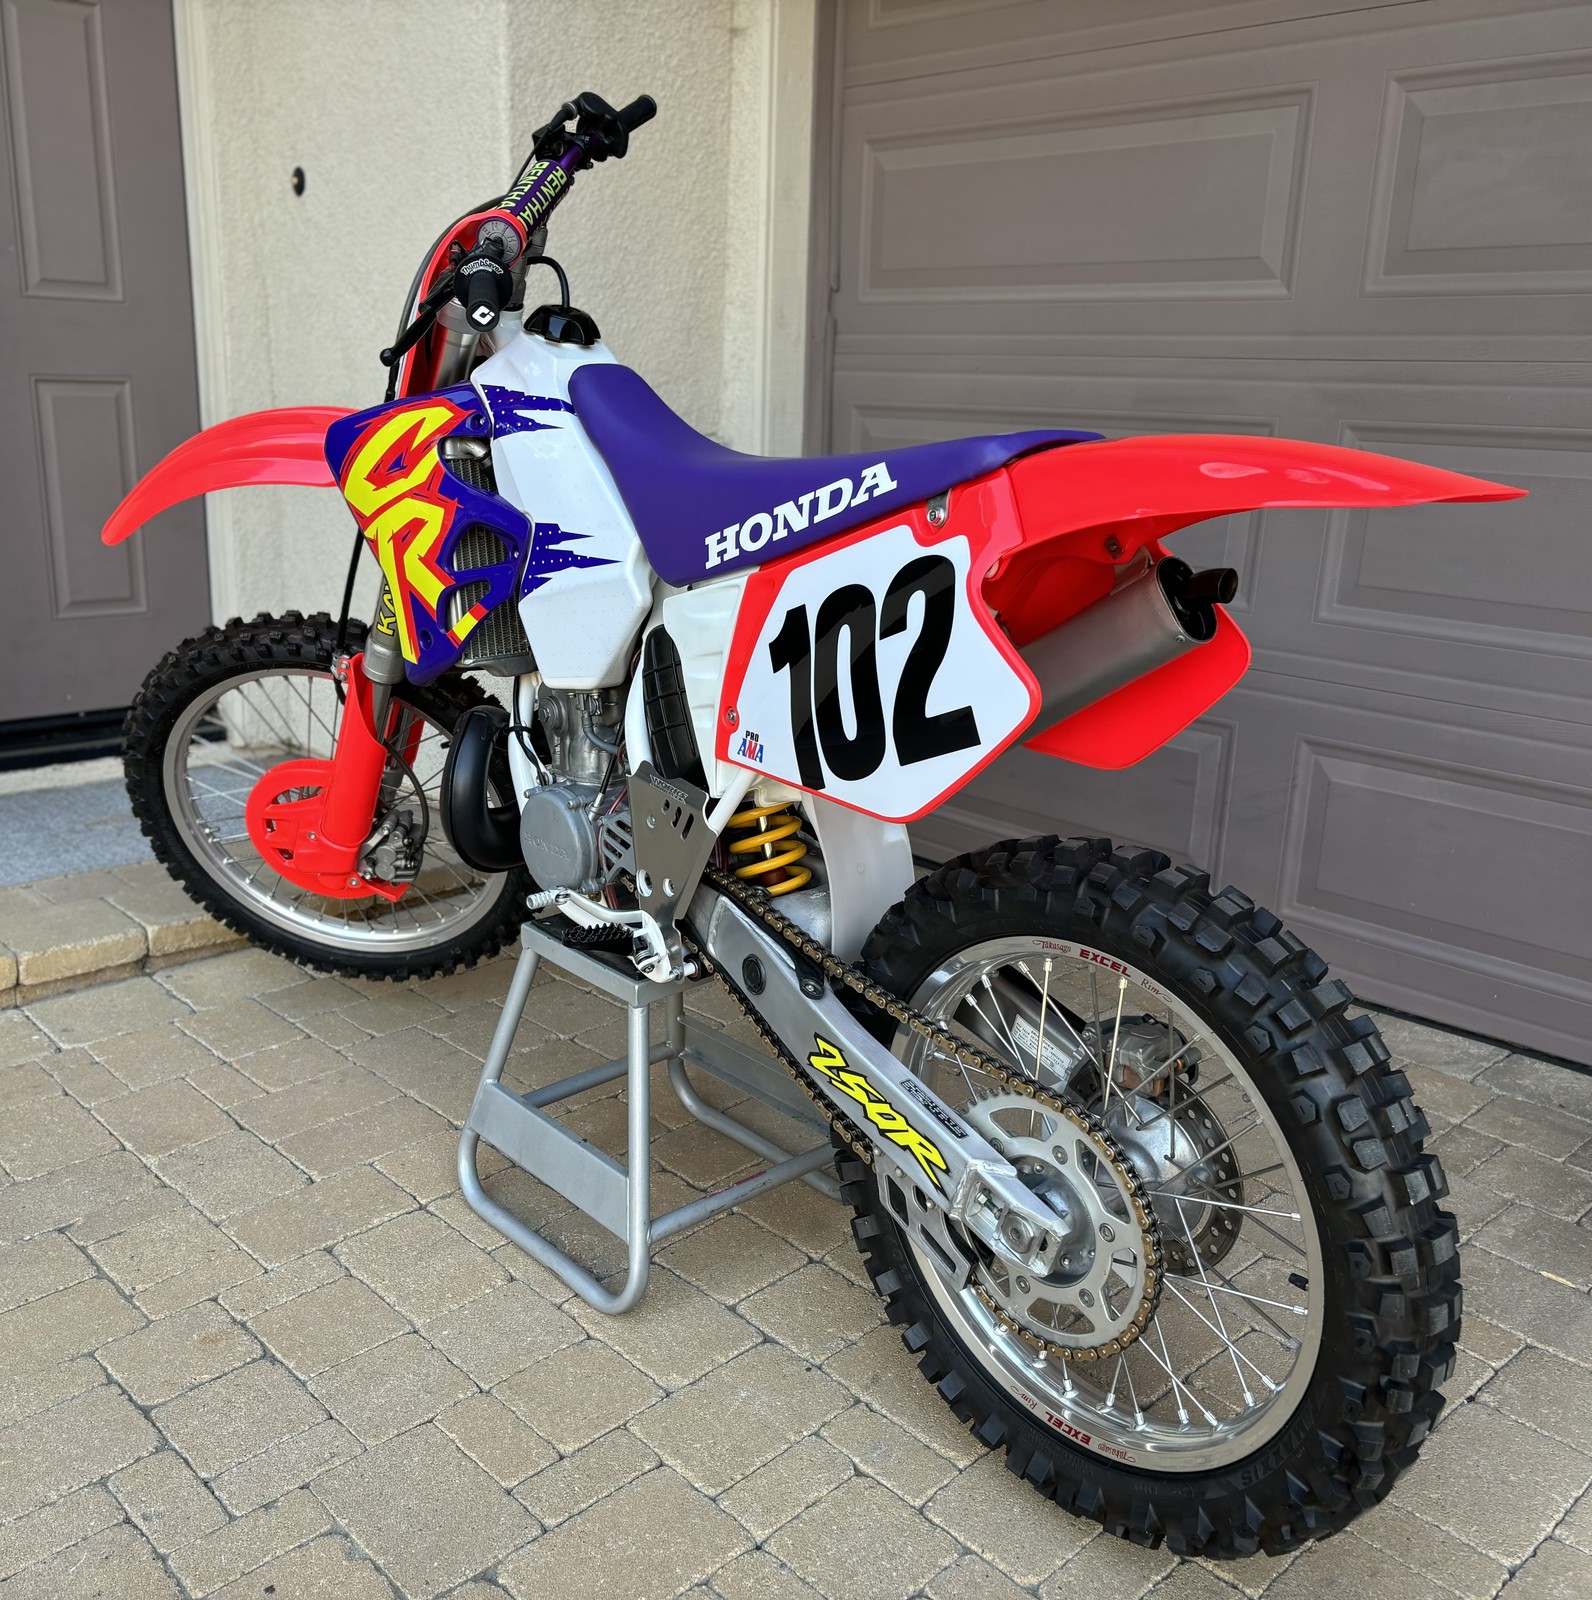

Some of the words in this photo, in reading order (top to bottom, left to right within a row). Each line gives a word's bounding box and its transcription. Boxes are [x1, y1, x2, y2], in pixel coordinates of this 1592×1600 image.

[500, 161, 550, 213] RENTHA
[705, 461, 897, 569] HONDA
[768, 554, 982, 791] 102
[737, 738, 764, 763] AMA
[745, 730, 759, 742] PRO
[1079, 947, 1131, 978] EXCEL
[808, 1034, 949, 1197] 250R
[1045, 1411, 1091, 1446] EXCEL
